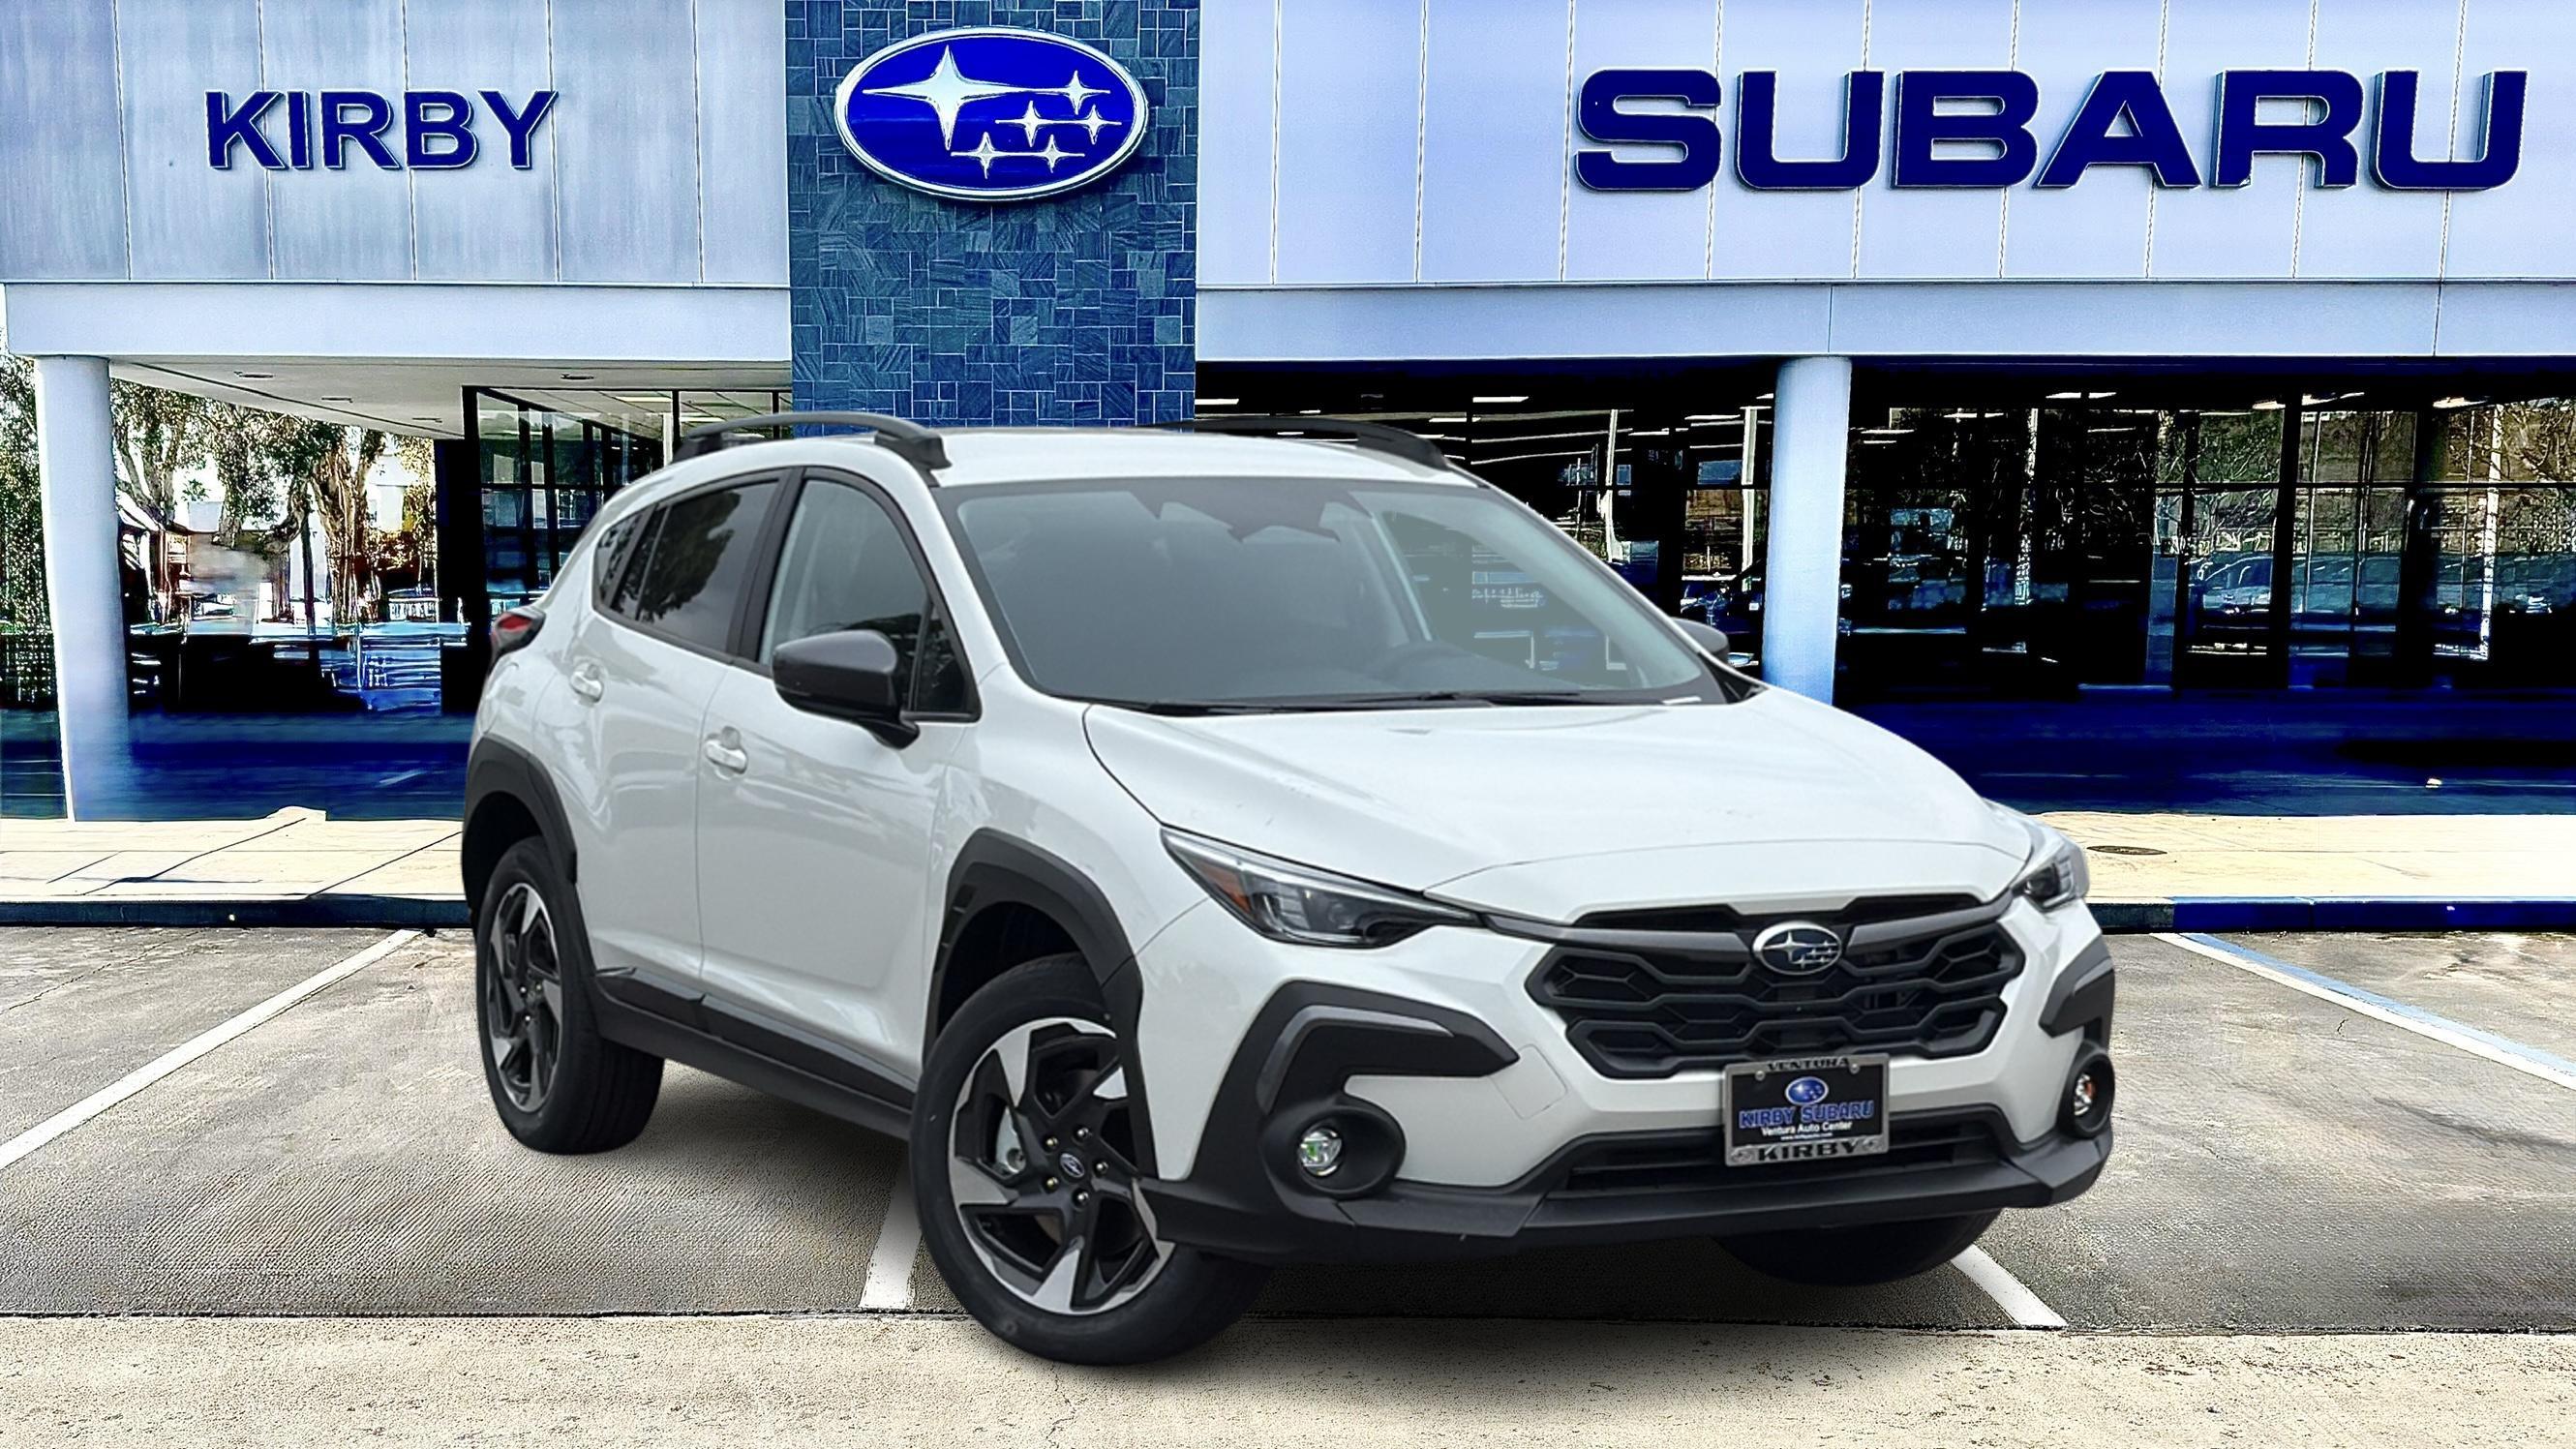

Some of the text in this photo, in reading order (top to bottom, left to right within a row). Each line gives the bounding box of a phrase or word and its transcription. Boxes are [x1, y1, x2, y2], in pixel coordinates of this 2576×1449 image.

[205, 90, 559, 170] KIRBY
[1575, 69, 2528, 193] SUBARU
[1767, 1056, 1850, 1072] VENTURA
[1739, 1101, 1874, 1129] KIRBY SUBARU
[1761, 1126, 1797, 1137] Ventura
[1797, 1123, 1821, 1134] Auto
[1821, 1120, 1853, 1132] Center
[1757, 1141, 1860, 1162] KIRBY
